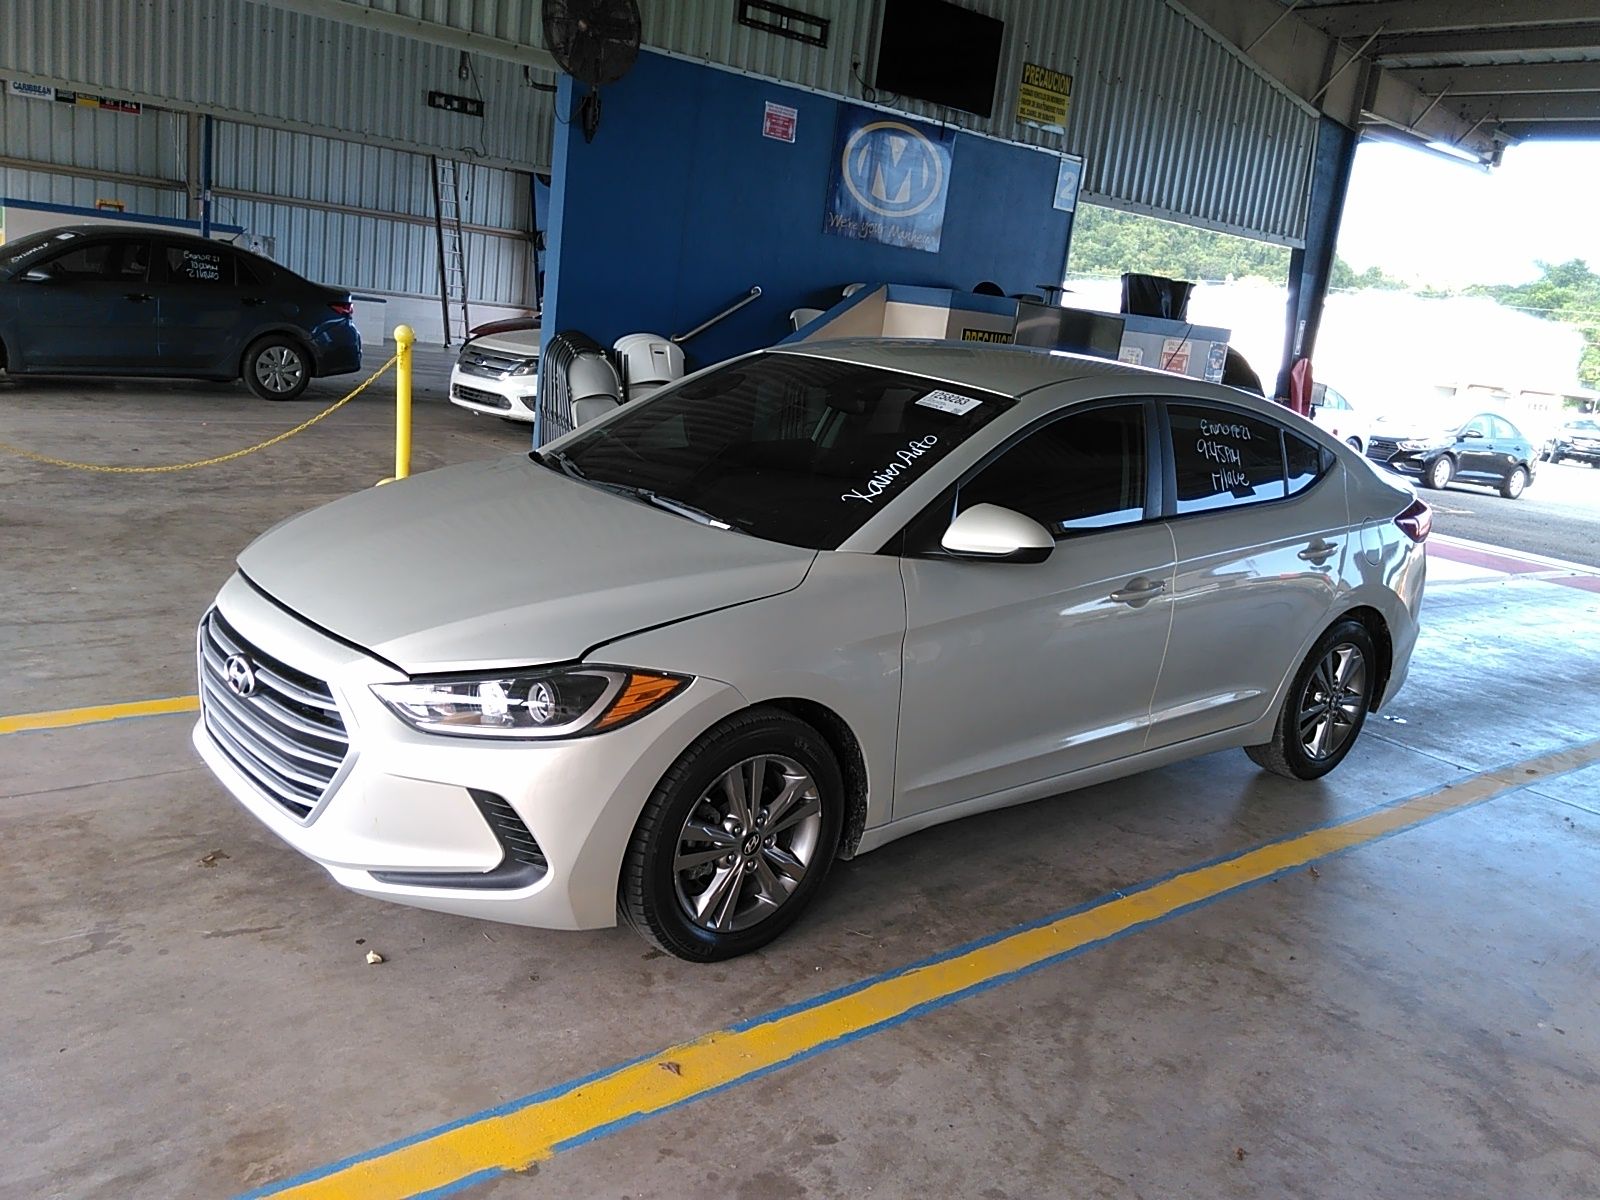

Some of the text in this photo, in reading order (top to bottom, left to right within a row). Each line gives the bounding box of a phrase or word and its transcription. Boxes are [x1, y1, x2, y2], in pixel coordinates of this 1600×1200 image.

[12, 81, 52, 96] CARIBBEAN
[1024, 64, 1072, 95] PRECAUCION
[1060, 171, 1077, 200] 2
[896, 434, 938, 466] Auto
